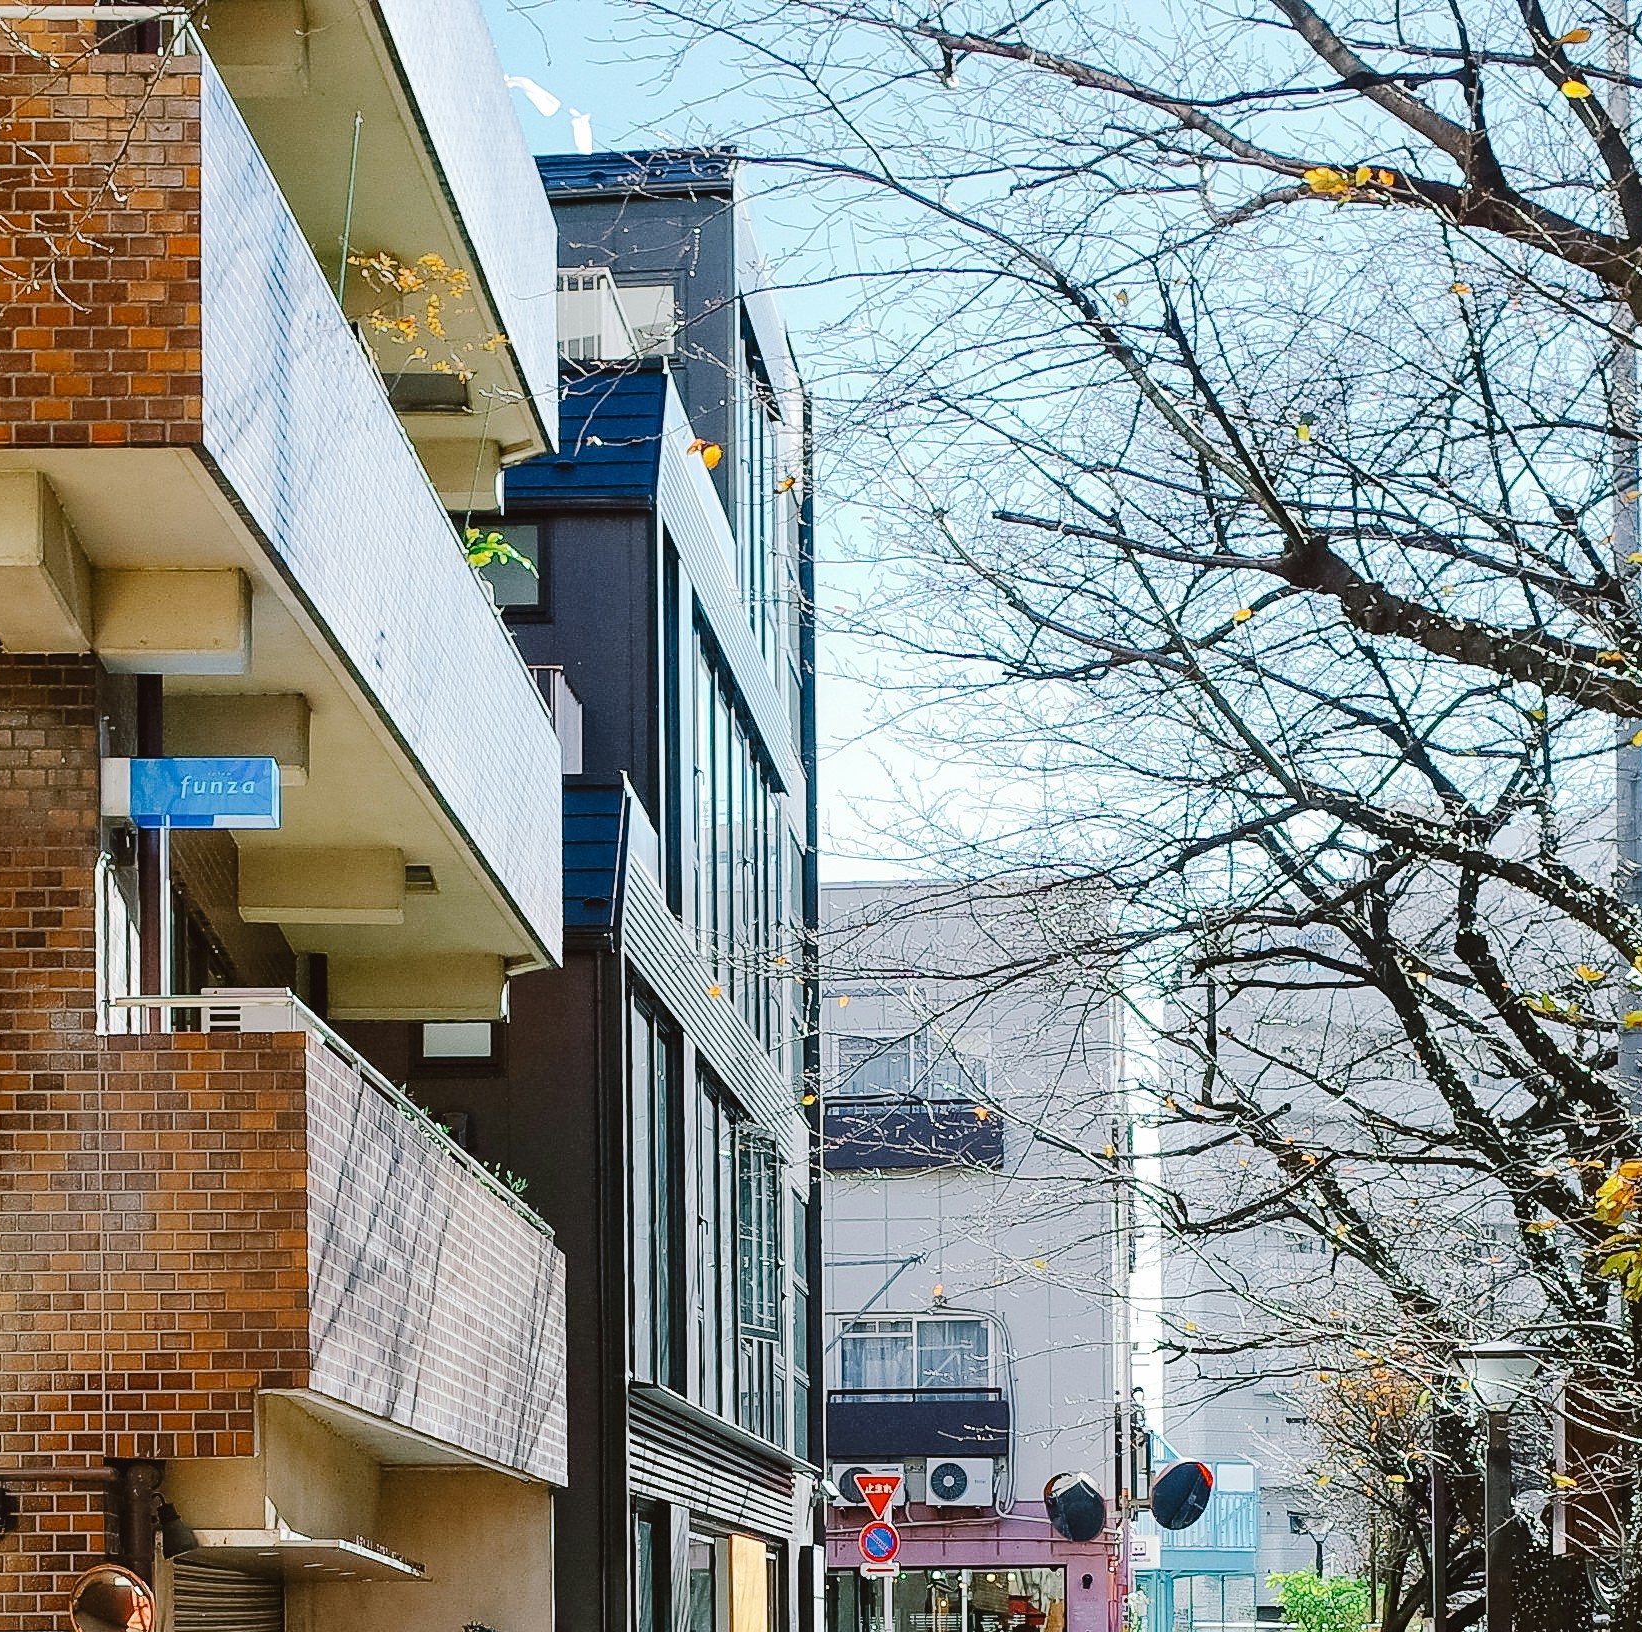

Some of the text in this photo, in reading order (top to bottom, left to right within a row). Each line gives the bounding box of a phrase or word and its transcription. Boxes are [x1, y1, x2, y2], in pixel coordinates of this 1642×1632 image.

[180, 775, 255, 800] funza
[864, 1482, 894, 1494] 止まれ
